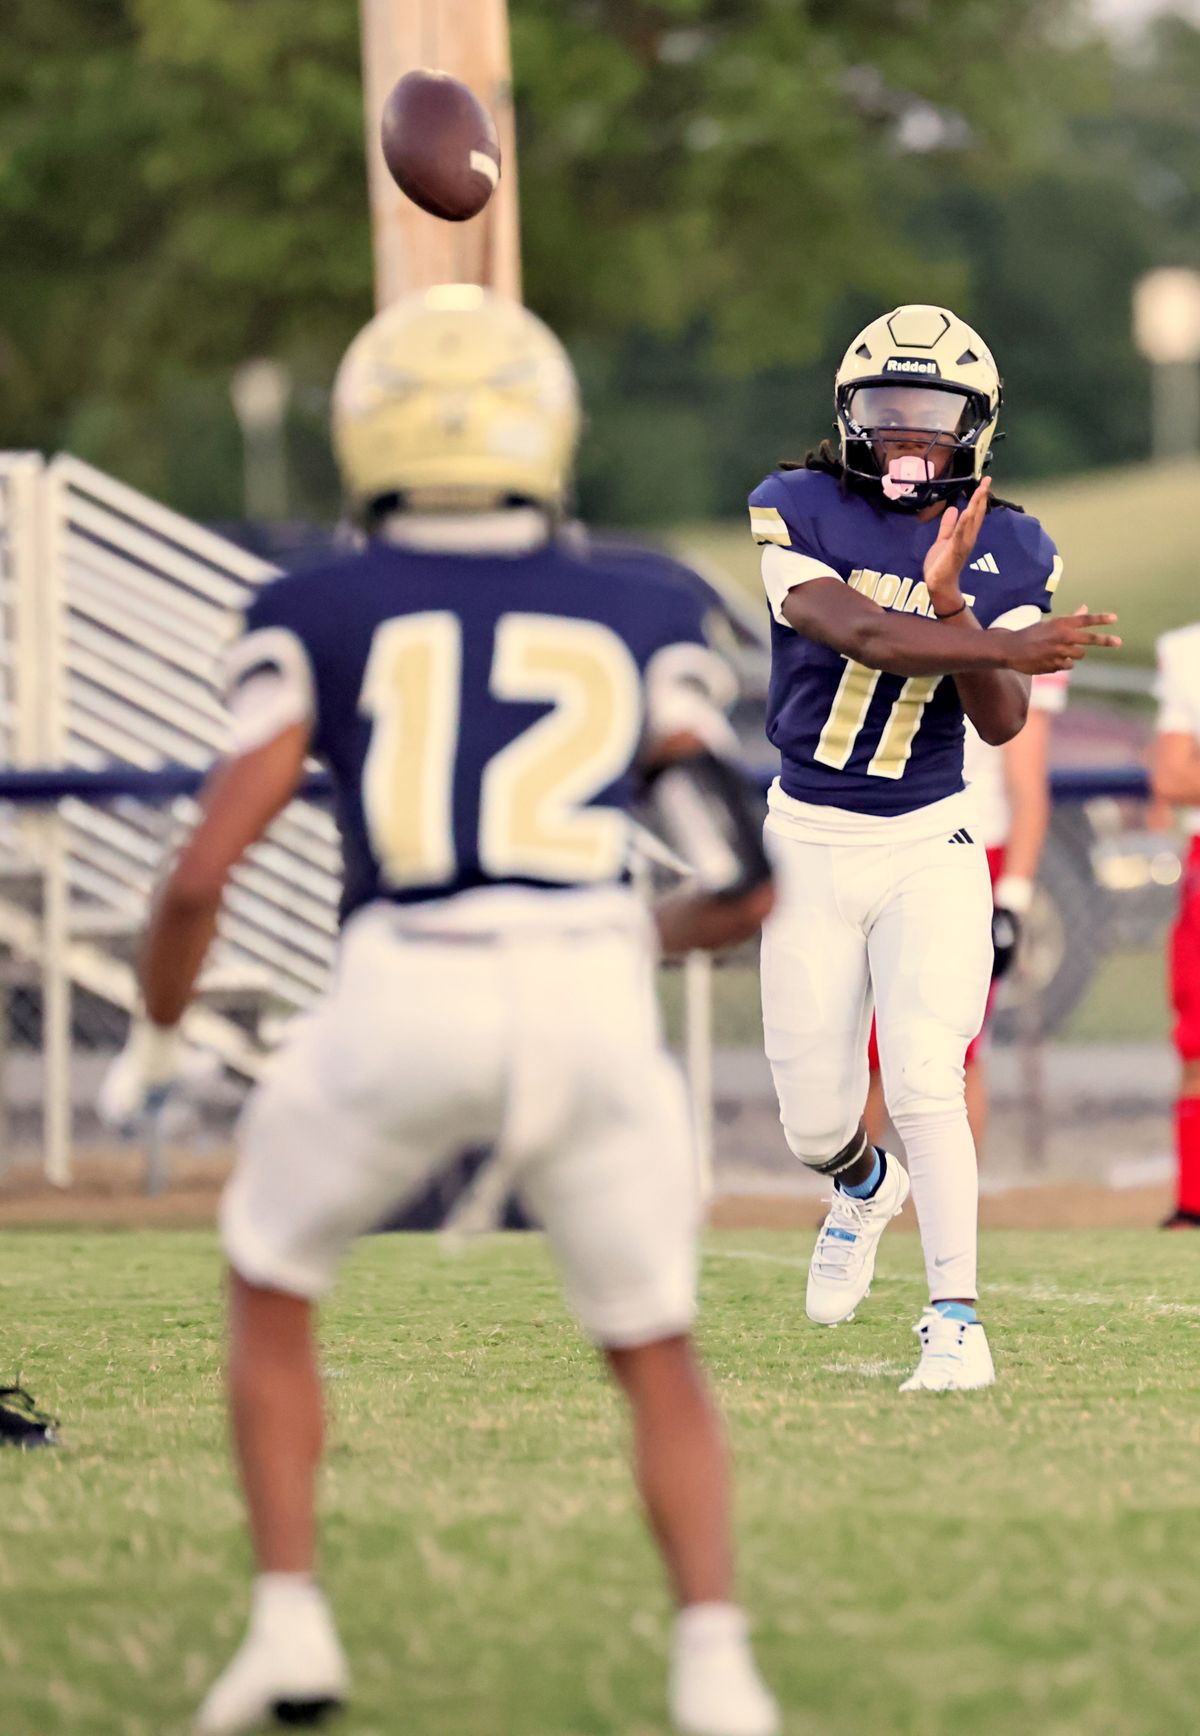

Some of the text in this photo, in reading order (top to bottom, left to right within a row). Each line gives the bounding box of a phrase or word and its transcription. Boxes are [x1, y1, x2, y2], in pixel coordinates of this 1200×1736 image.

[887, 360, 937, 374] Riddell
[848, 568, 976, 620] INDIA
[358, 609, 644, 887] 12
